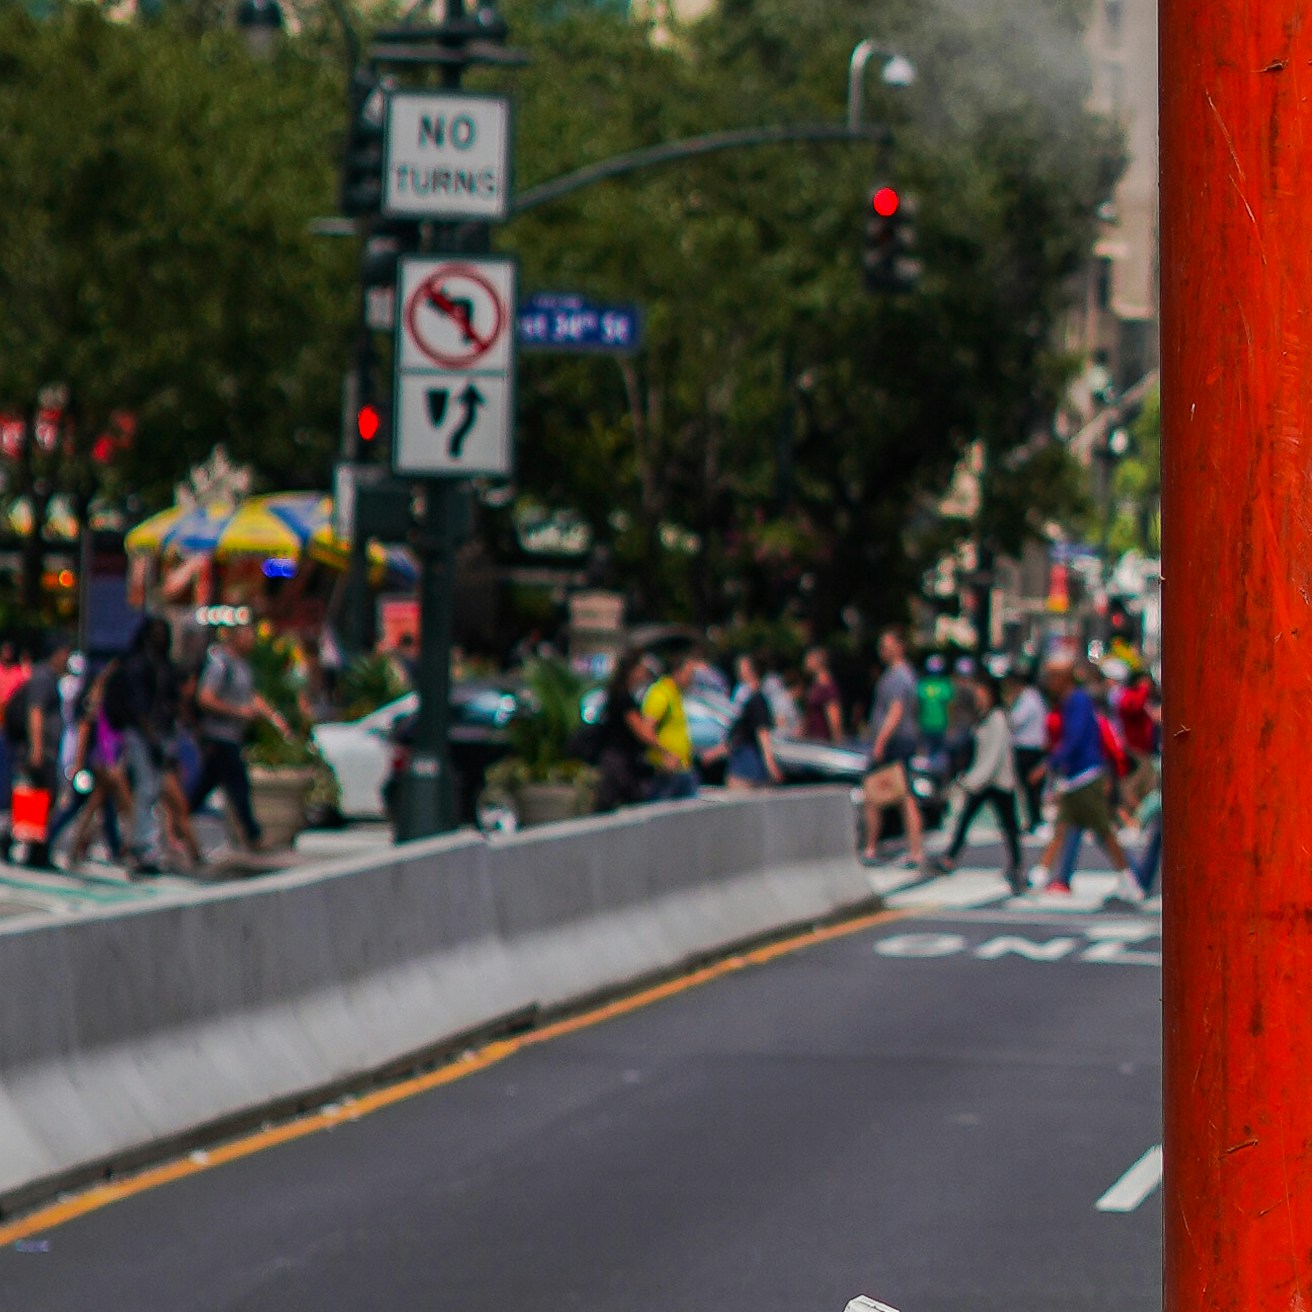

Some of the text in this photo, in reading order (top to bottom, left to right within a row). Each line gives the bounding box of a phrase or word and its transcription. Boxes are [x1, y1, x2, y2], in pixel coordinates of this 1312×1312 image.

[419, 114, 477, 150] NO
[396, 165, 496, 198] TURNS
[873, 934, 1162, 966] ONL
